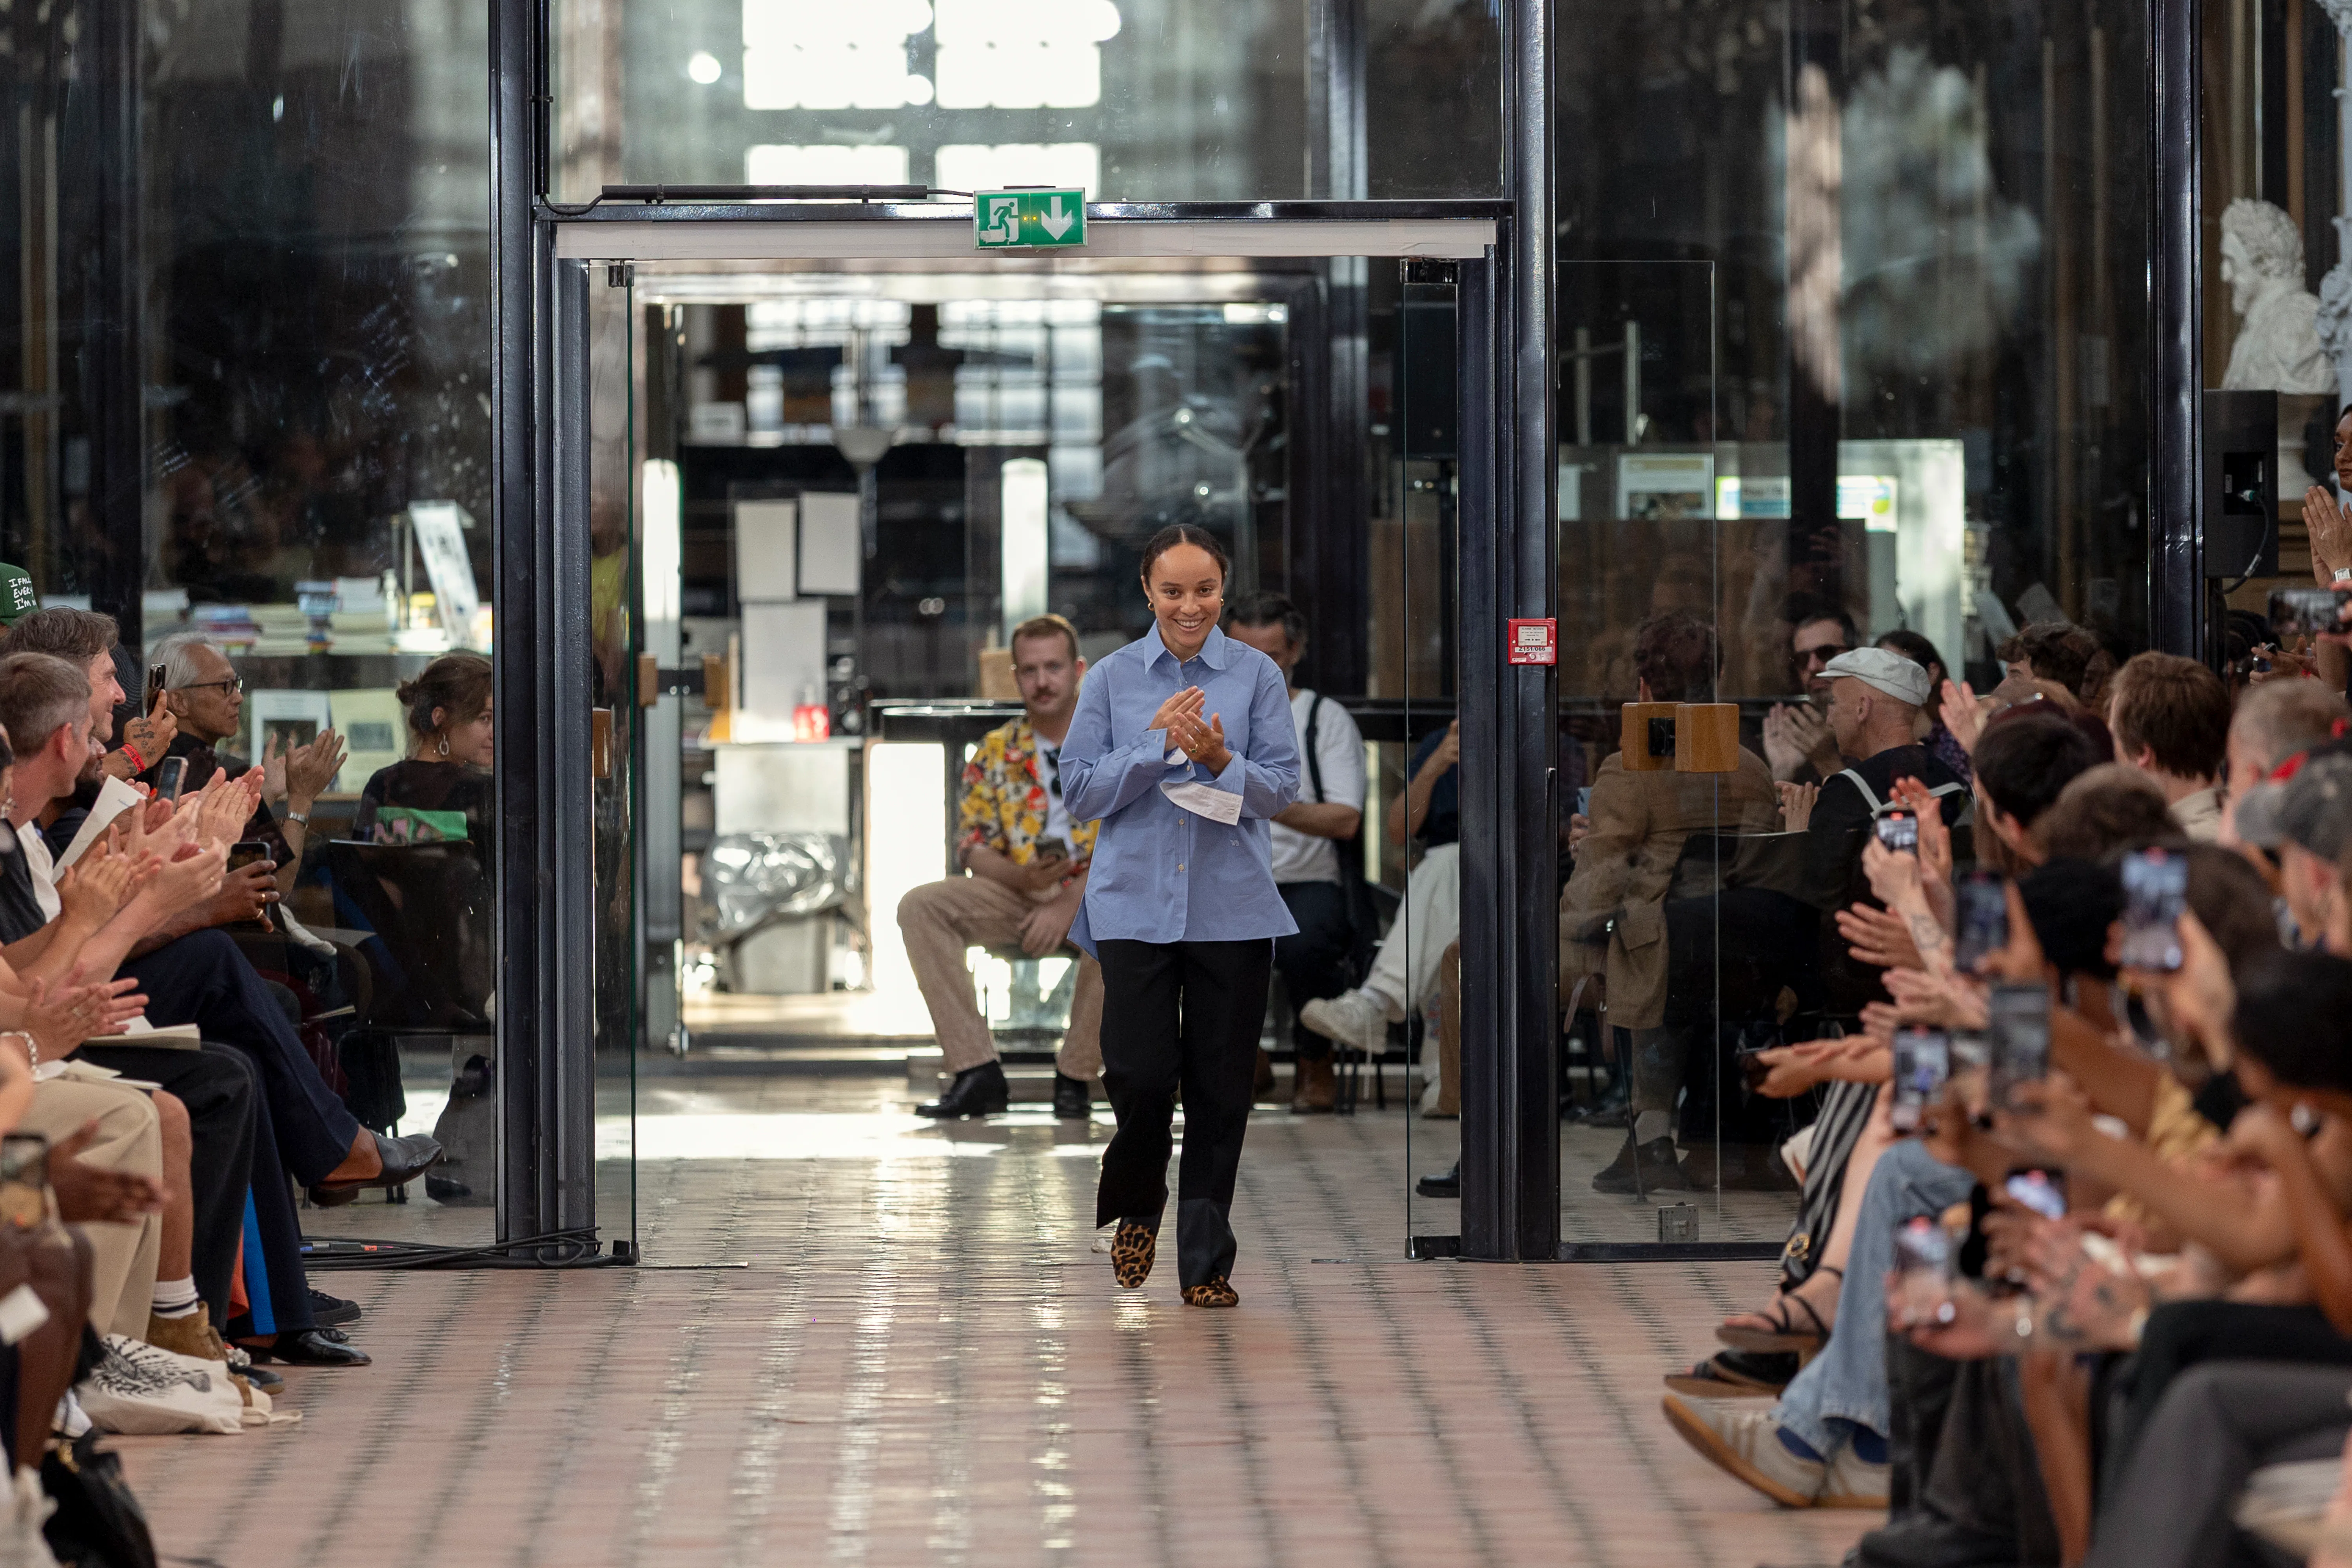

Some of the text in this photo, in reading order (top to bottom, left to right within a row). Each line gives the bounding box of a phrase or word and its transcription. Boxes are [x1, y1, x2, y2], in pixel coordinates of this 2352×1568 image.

[8, 577, 31, 588] I FALL
[14, 597, 31, 610] I'M
